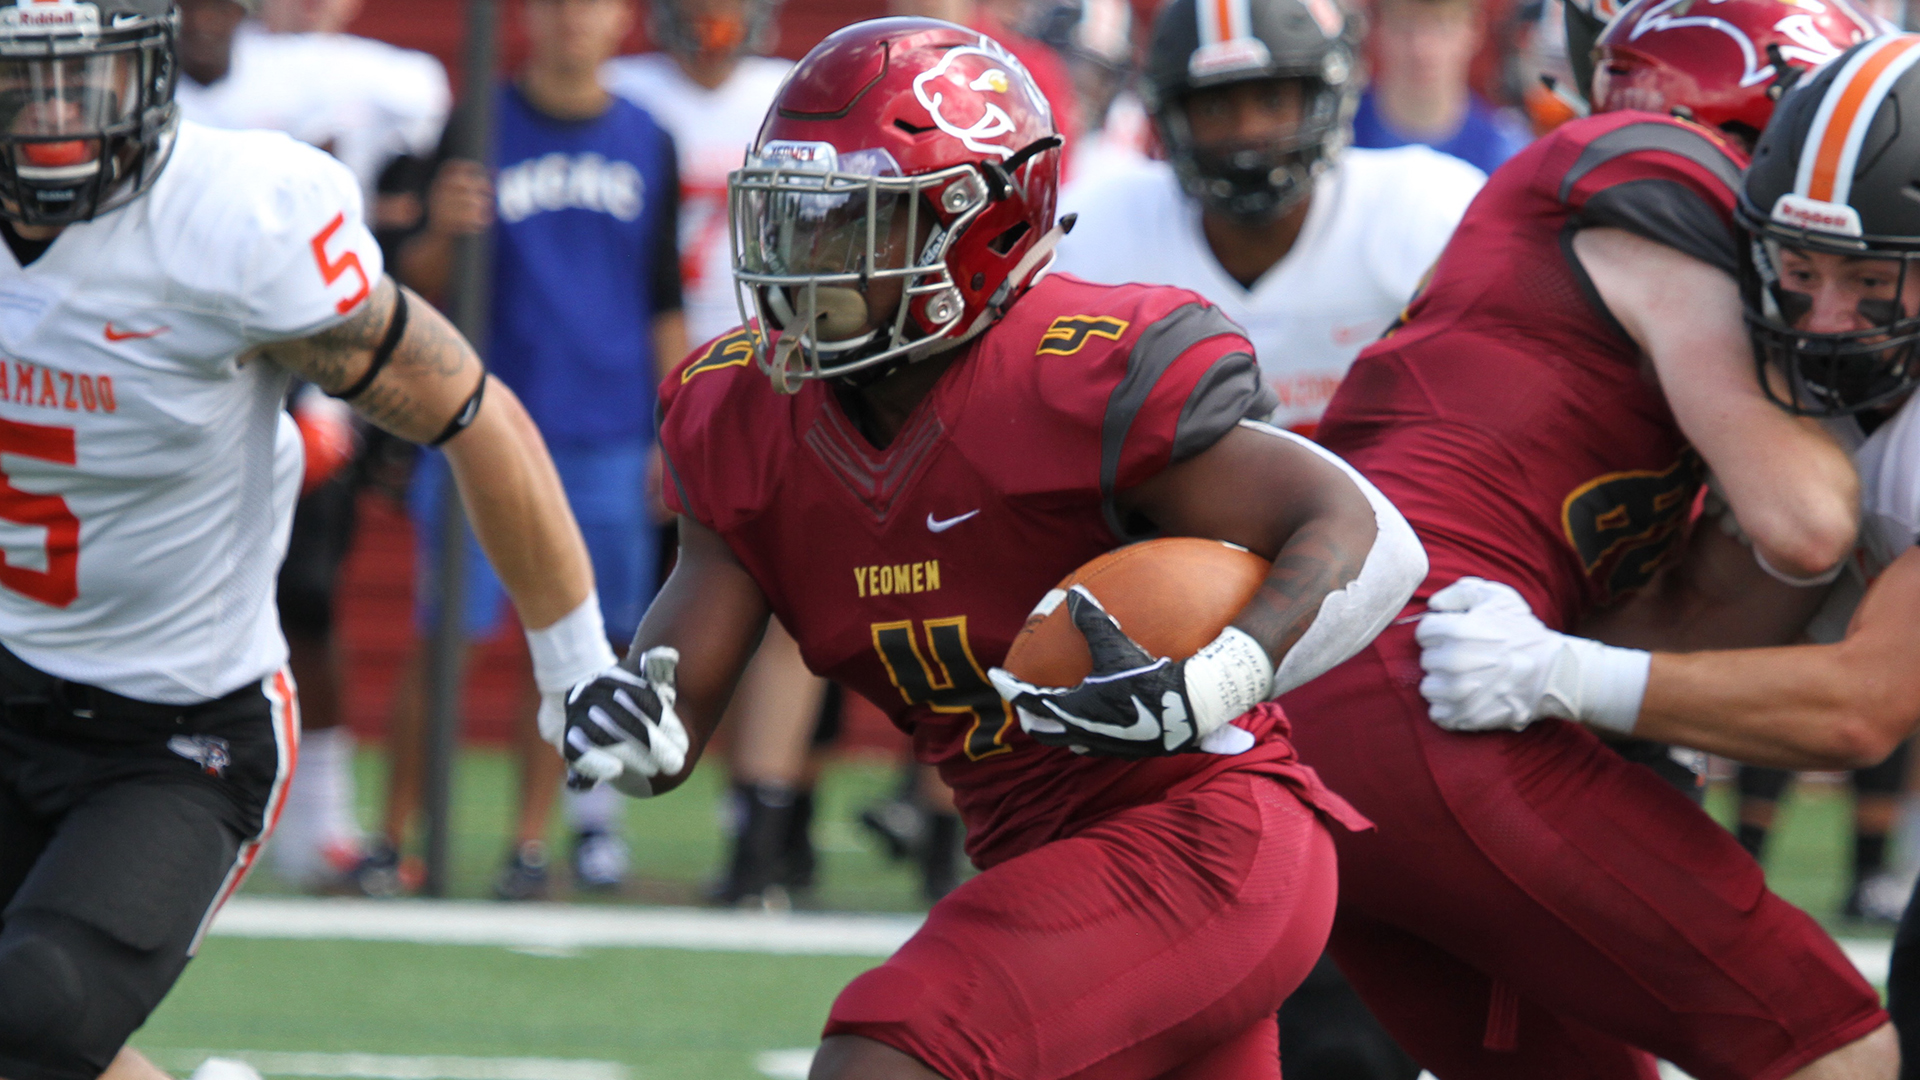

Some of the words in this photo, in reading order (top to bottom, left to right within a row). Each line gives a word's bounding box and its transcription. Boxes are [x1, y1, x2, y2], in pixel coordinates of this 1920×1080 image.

[20, 11, 74, 25] Riddell
[771, 145, 816, 161] YEOMEN
[310, 211, 370, 315] 5
[681, 328, 763, 385] 4
[1035, 314, 1130, 356] 4
[0, 416, 80, 610] 5
[853, 559, 941, 598] YEOMEN
[870, 615, 1014, 762] 4
